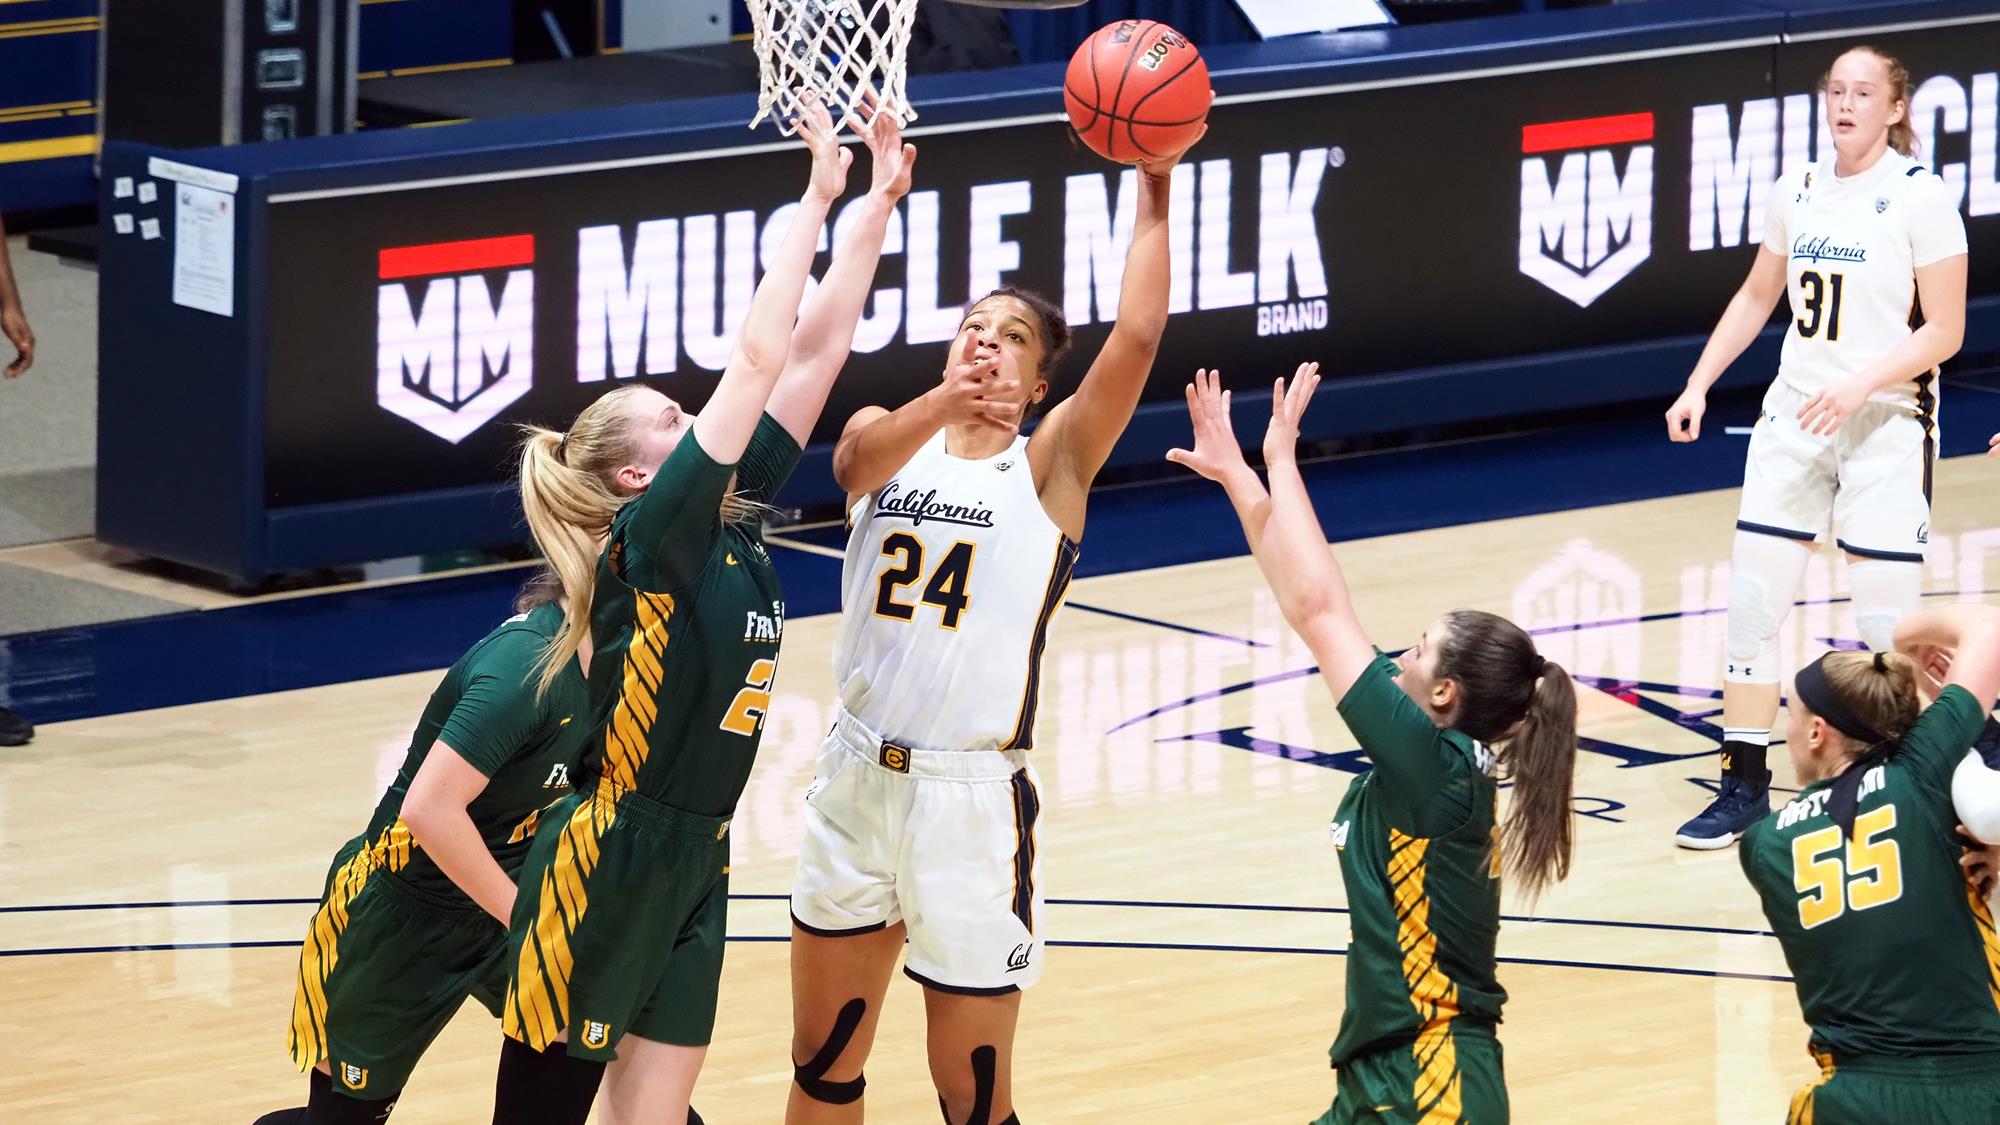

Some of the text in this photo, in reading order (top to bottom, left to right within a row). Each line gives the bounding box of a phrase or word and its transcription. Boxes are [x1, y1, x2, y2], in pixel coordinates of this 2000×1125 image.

[1137, 29, 1190, 71] ilson
[1792, 232, 1867, 264] California
[1257, 300, 1328, 336] BRAND
[1797, 270, 1844, 342] 31
[873, 479, 994, 528] California
[873, 530, 977, 632] 24
[1792, 803, 1904, 930] 55
[1005, 942, 1034, 974] Cal
